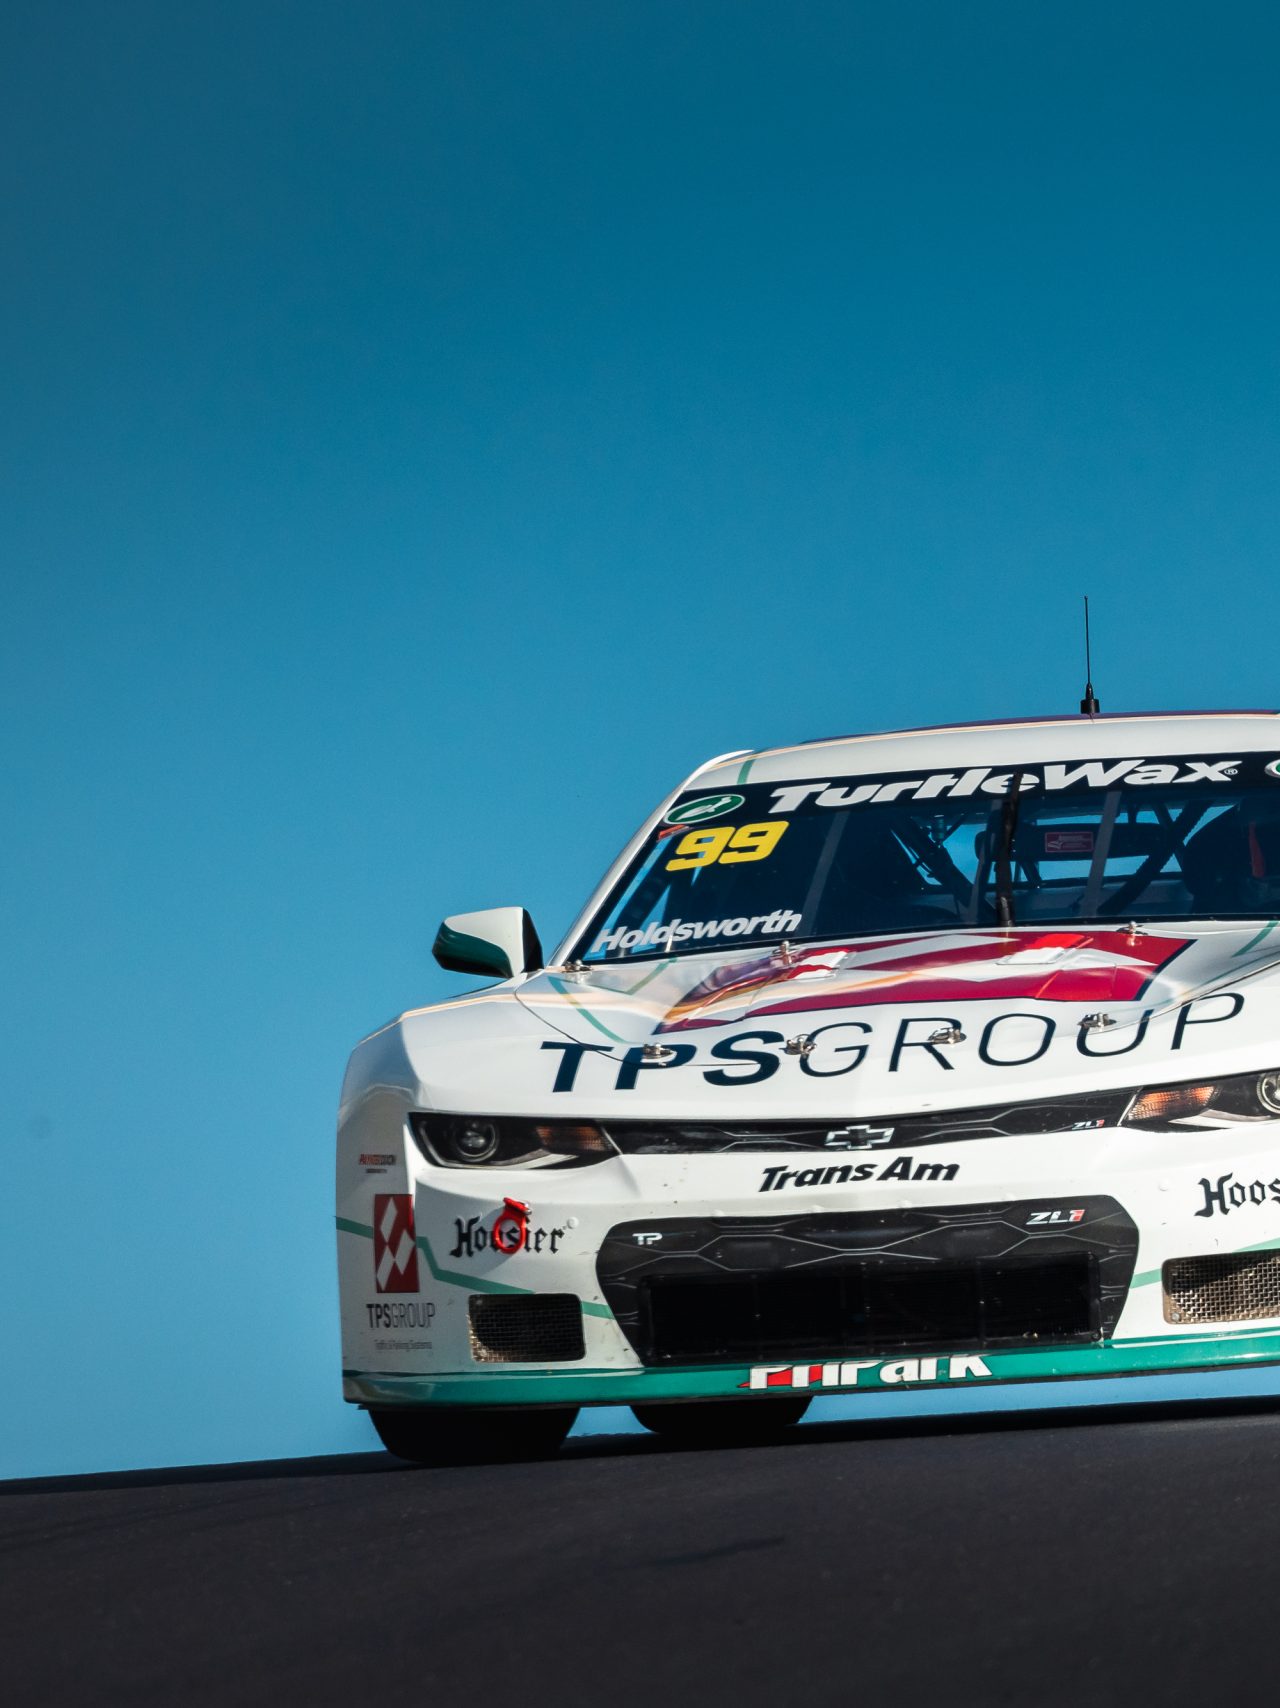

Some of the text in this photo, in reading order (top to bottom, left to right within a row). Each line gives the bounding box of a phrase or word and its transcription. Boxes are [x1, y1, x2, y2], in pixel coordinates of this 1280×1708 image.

[665, 821, 789, 872] 99
[590, 909, 802, 953] Holdsworth
[1071, 1119, 1105, 1131] ZL1
[758, 1156, 961, 1193] Trans Am
[1025, 1209, 1086, 1226] ZL1
[631, 1232, 663, 1246] TP
[366, 1302, 436, 1330] TPSGROUP
